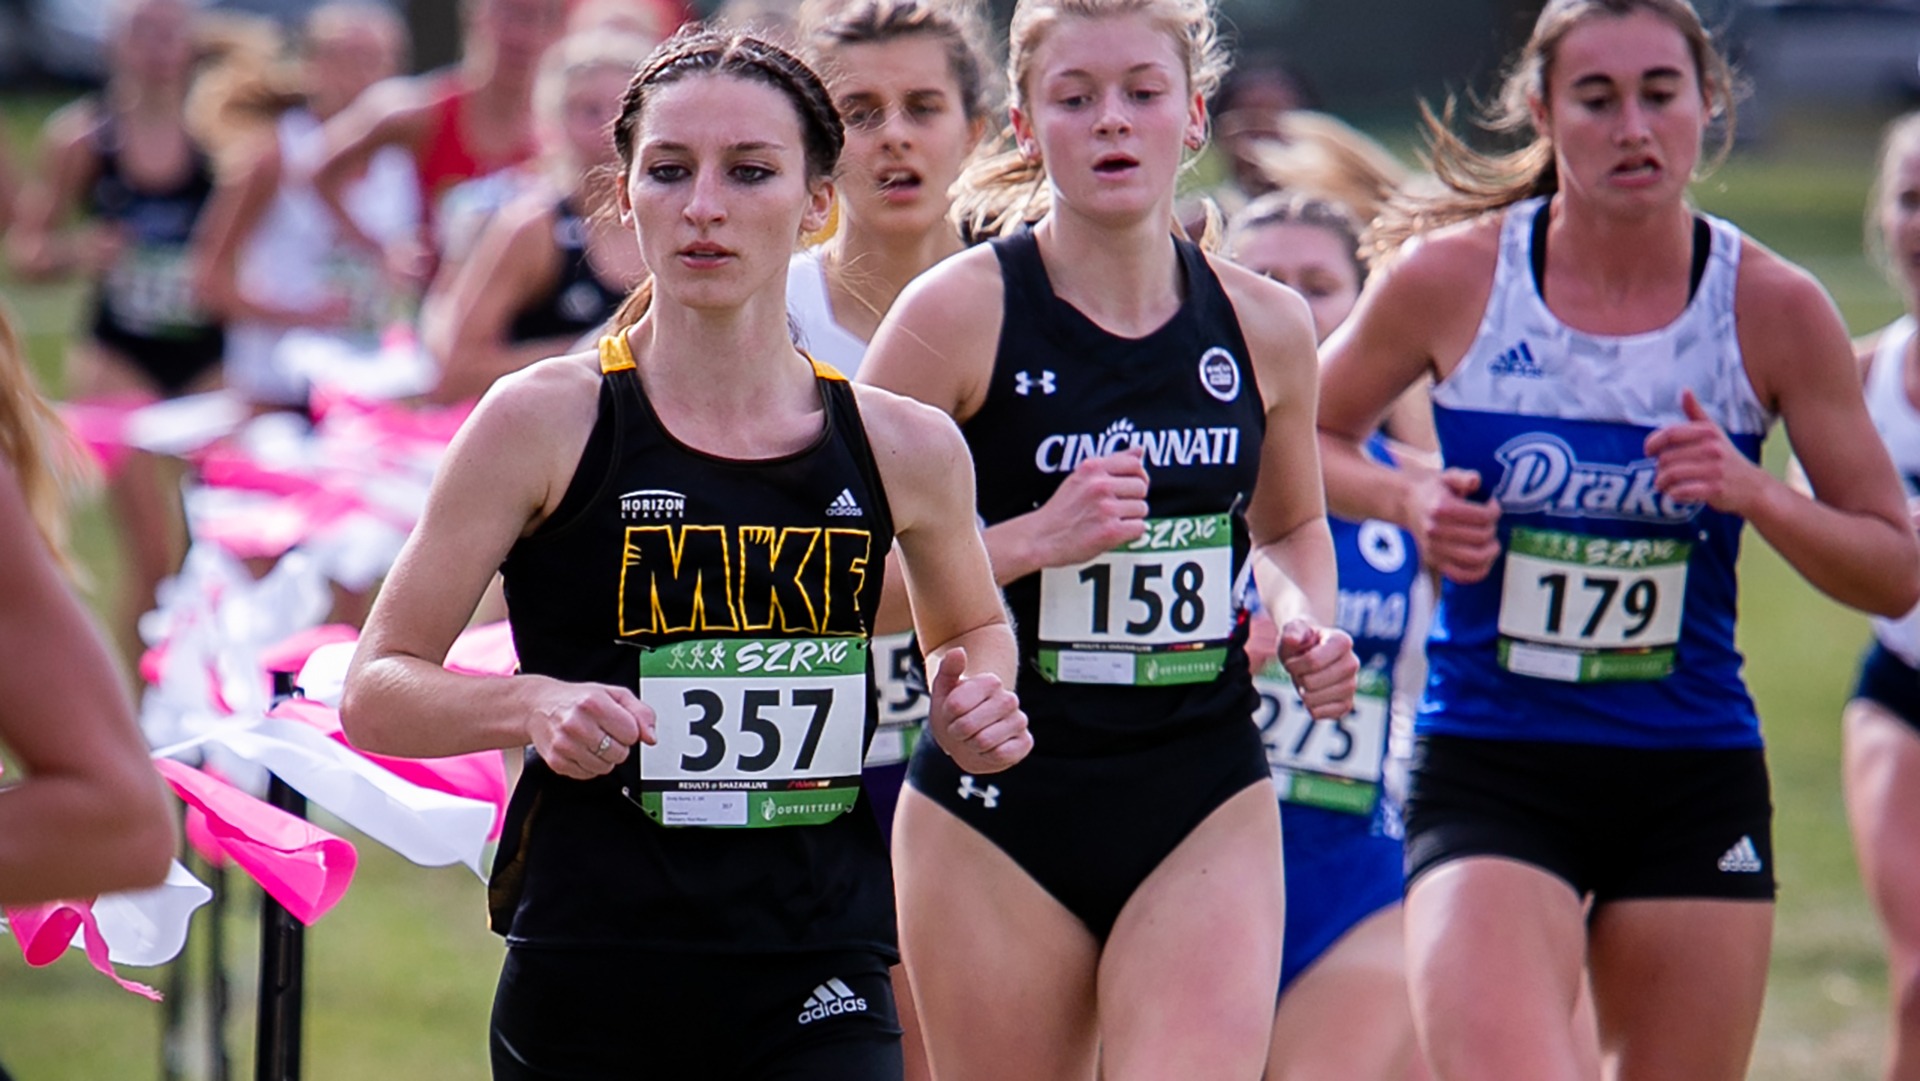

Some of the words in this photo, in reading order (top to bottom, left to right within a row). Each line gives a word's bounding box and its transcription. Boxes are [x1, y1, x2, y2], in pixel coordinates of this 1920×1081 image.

[621, 499, 684, 511] HORIZON
[825, 505, 863, 517] adidas
[621, 511, 684, 519] LEAGUE
[1078, 561, 1205, 635] 158
[1539, 573, 1658, 639] 179
[680, 688, 834, 772] 357
[678, 781, 710, 790] RESULTS
[777, 803, 843, 815] OUTFITTERS
[797, 997, 868, 1025] adidas
